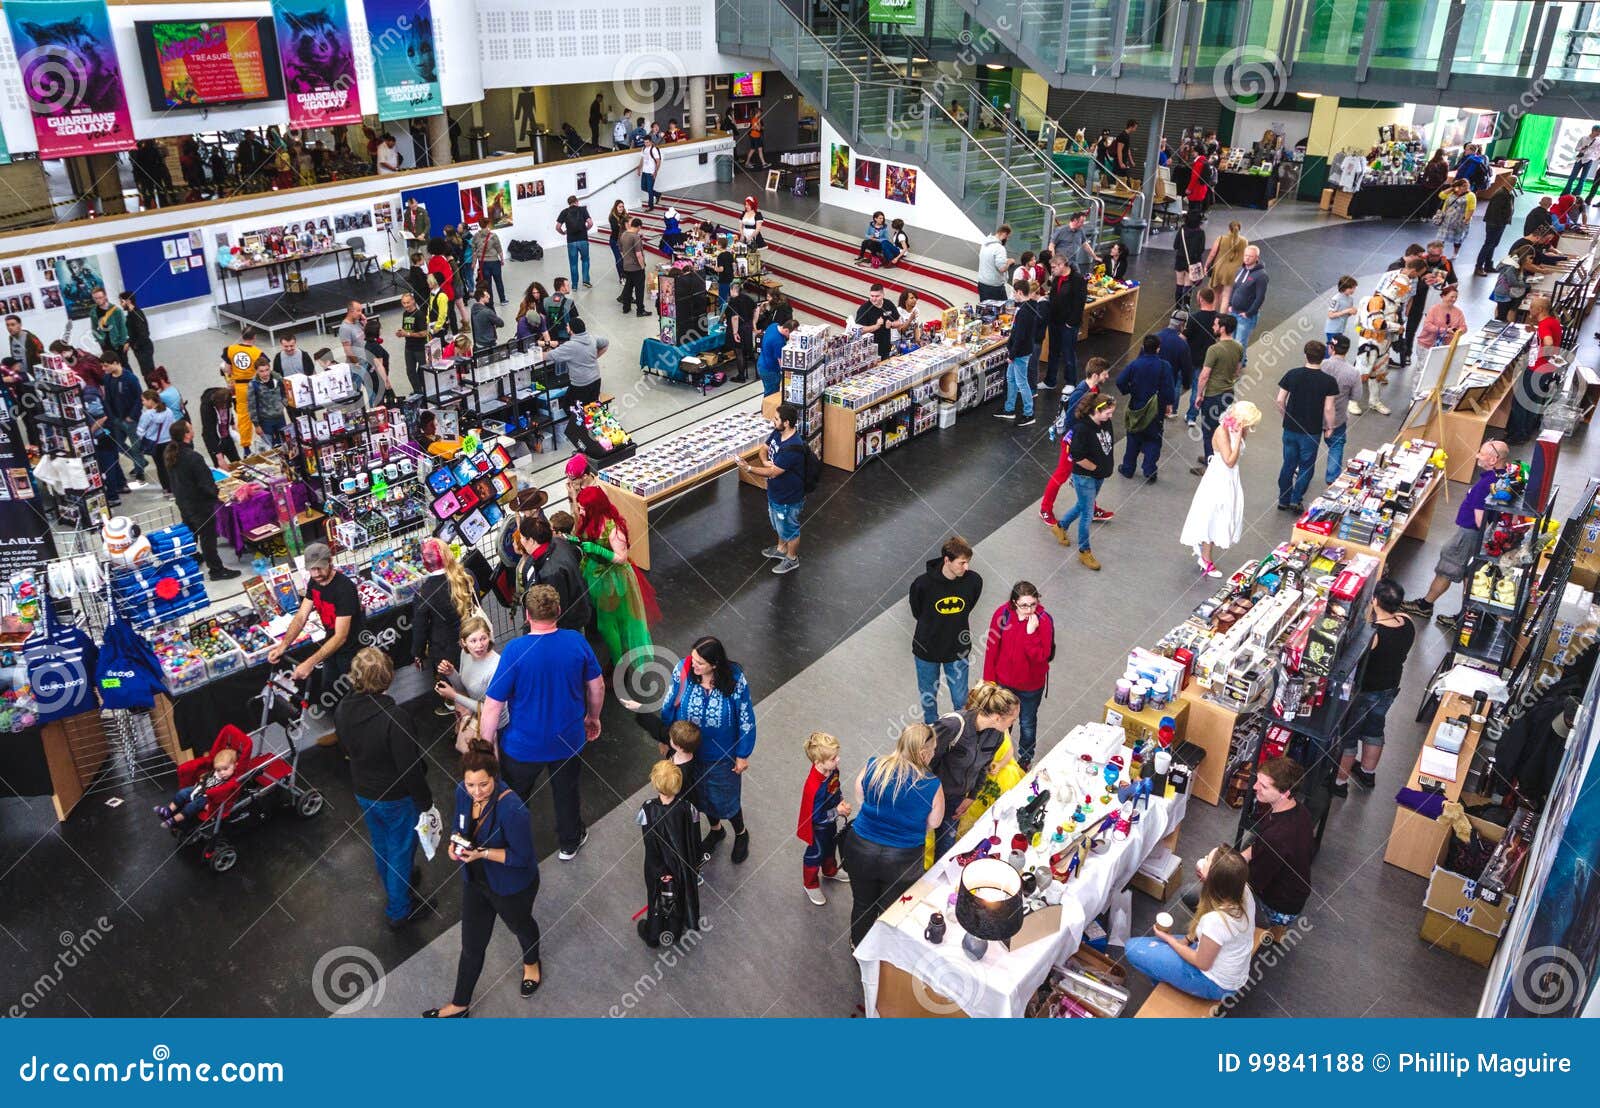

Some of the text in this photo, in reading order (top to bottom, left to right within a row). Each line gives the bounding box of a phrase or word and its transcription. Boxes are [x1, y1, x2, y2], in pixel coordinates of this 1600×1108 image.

[191, 53, 232, 62] TREASURE
[385, 84, 430, 96] GUARDIANS
[297, 90, 348, 103] GUARDIANS
[310, 98, 347, 109] GALAXY
[47, 112, 116, 128] GUARDIANS
[66, 121, 116, 136] GALAXY
